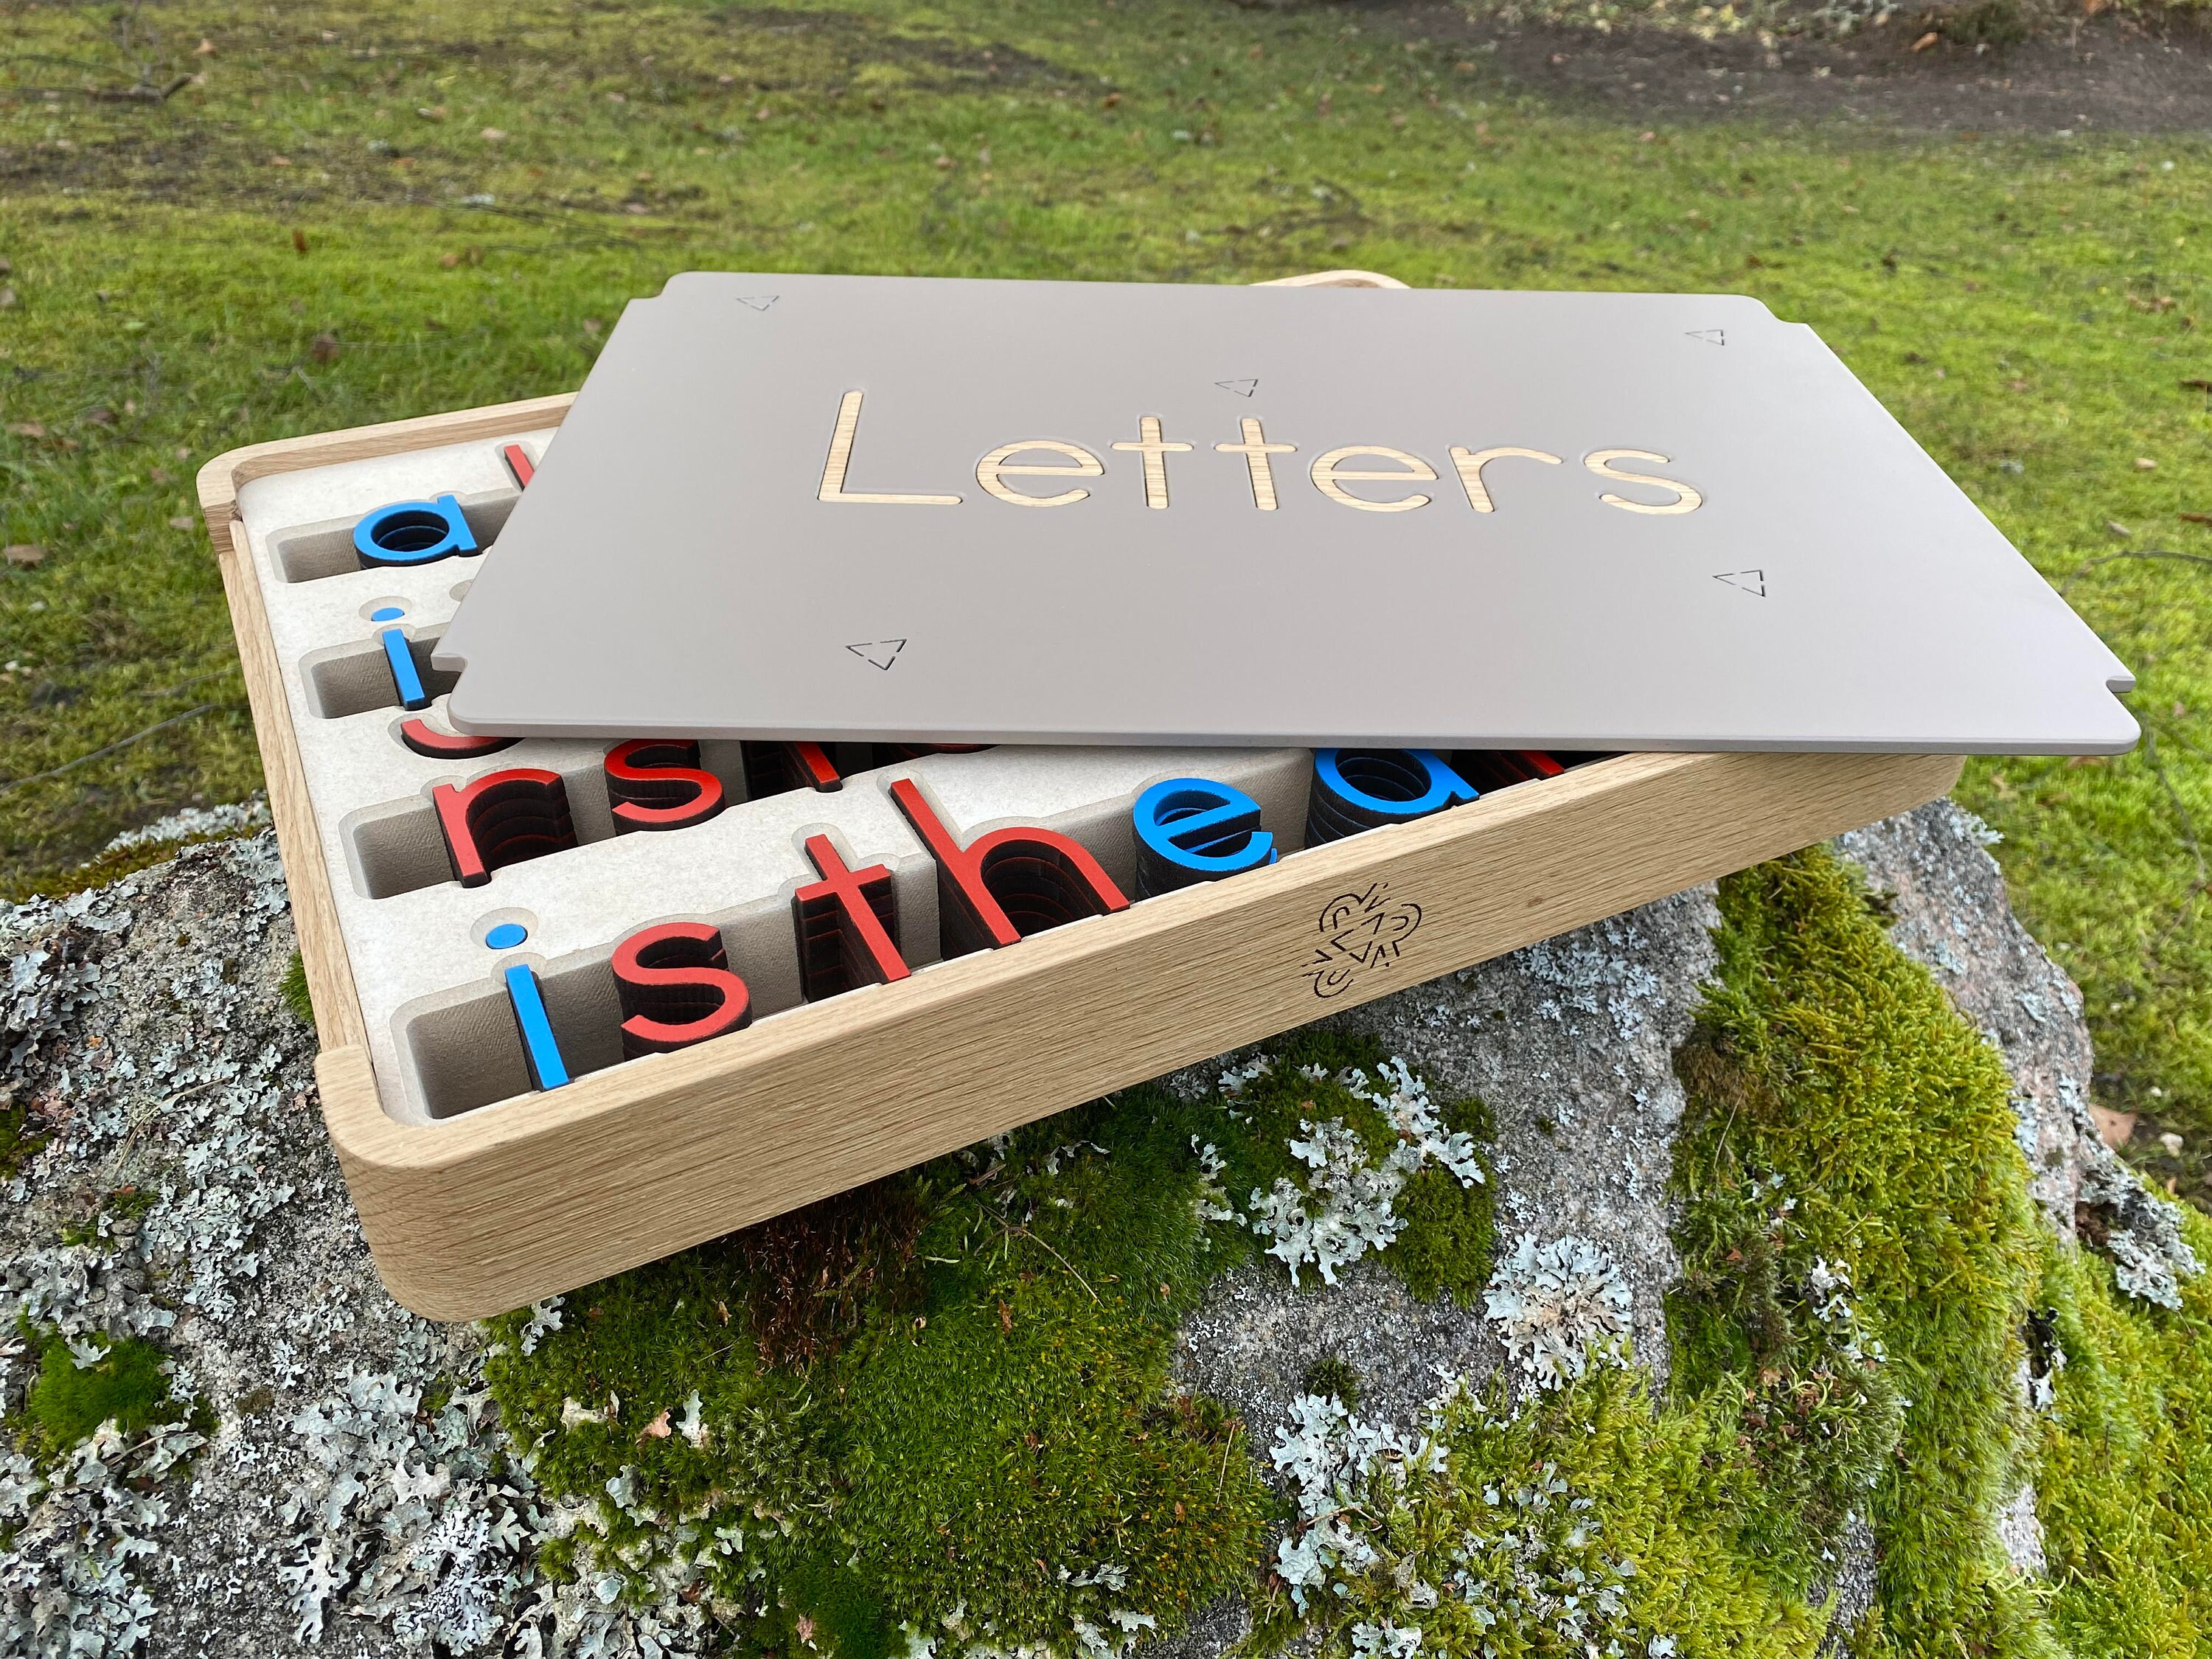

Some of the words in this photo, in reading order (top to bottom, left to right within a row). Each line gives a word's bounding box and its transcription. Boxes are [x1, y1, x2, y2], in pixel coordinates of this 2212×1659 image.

[817, 390, 1703, 515] Letters
[353, 494, 480, 565] a
[371, 607, 425, 706] i
